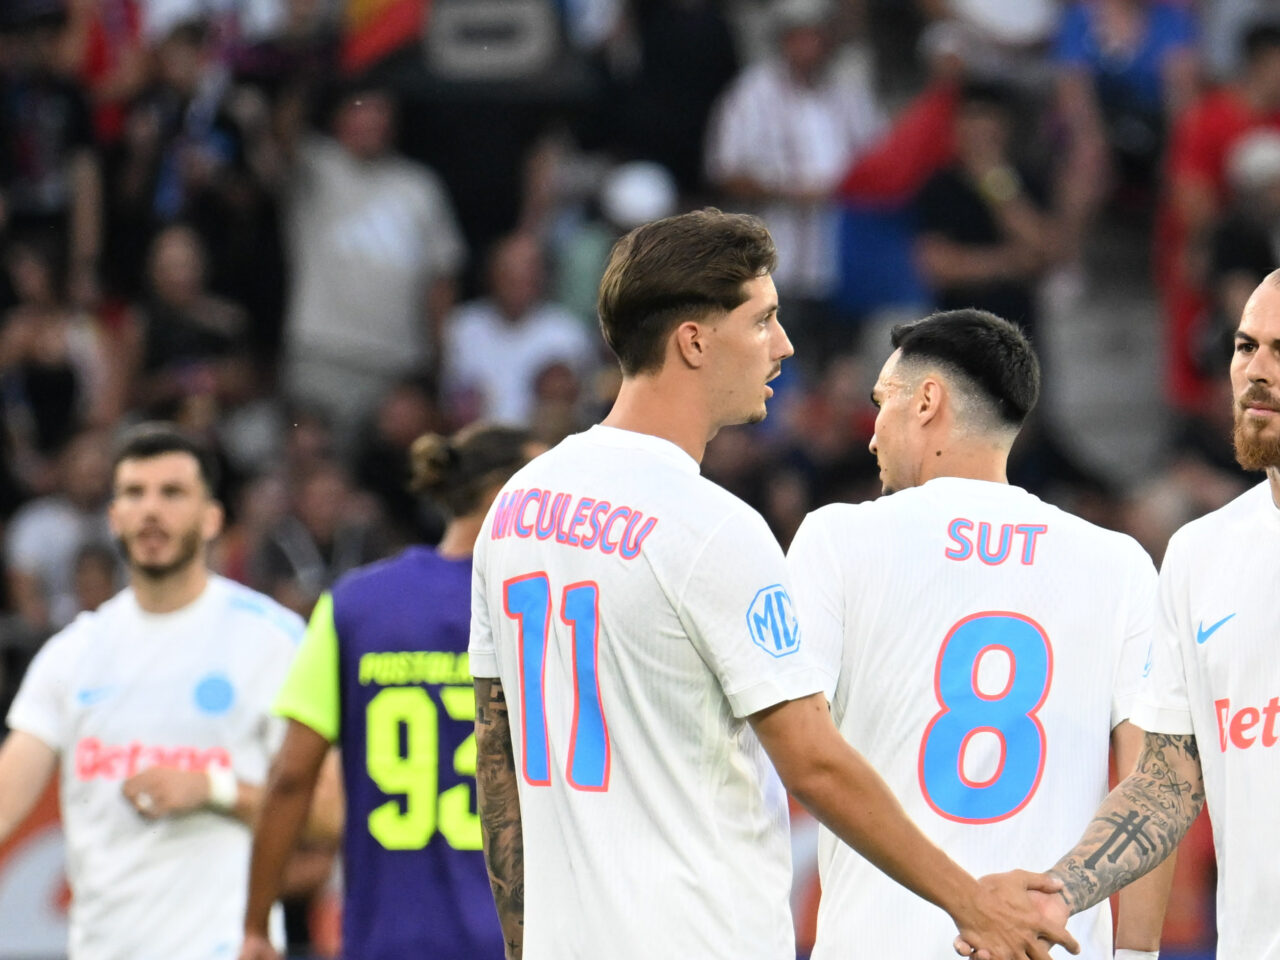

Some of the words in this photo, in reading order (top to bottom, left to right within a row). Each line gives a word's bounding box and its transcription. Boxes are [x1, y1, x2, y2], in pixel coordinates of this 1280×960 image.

[944, 517, 1048, 566] SUT
[502, 570, 611, 793] 11
[918, 610, 1054, 825] 8
